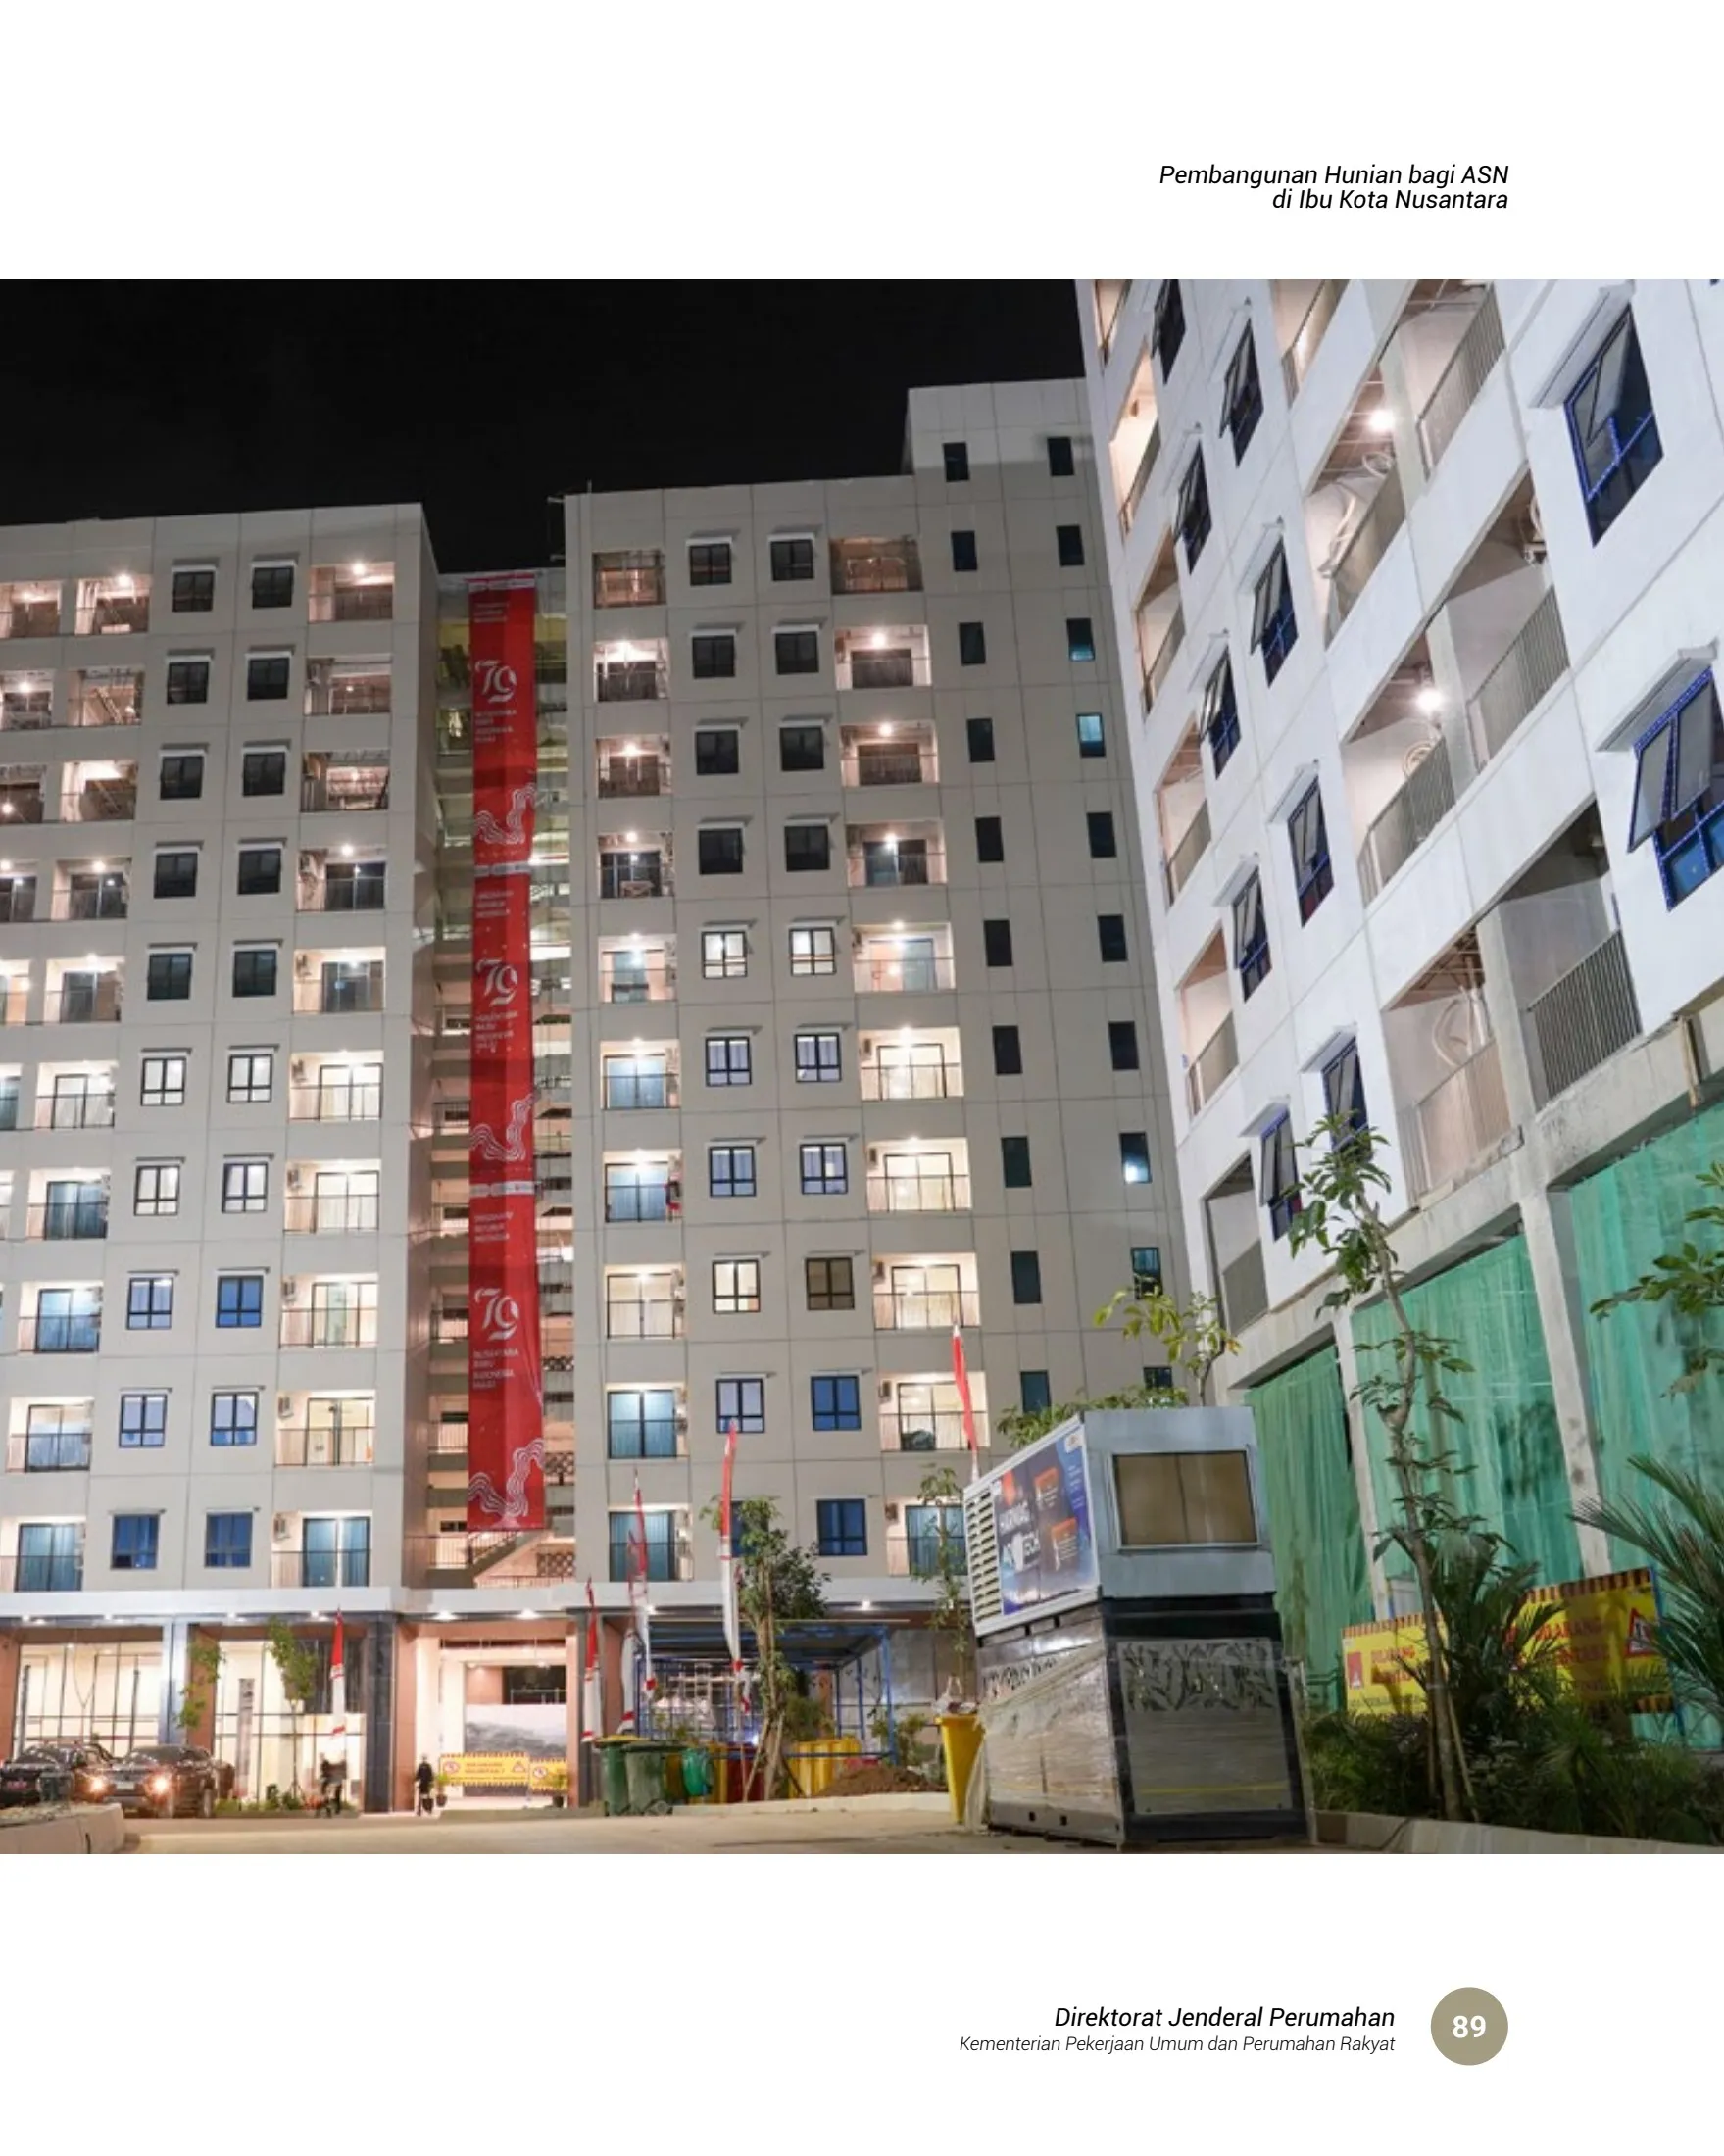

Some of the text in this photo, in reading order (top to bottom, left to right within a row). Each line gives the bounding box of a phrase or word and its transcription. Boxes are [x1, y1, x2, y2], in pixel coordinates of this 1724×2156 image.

[474, 660, 517, 703] 79
[475, 959, 518, 1007] 79
[474, 1288, 519, 1342] 79
